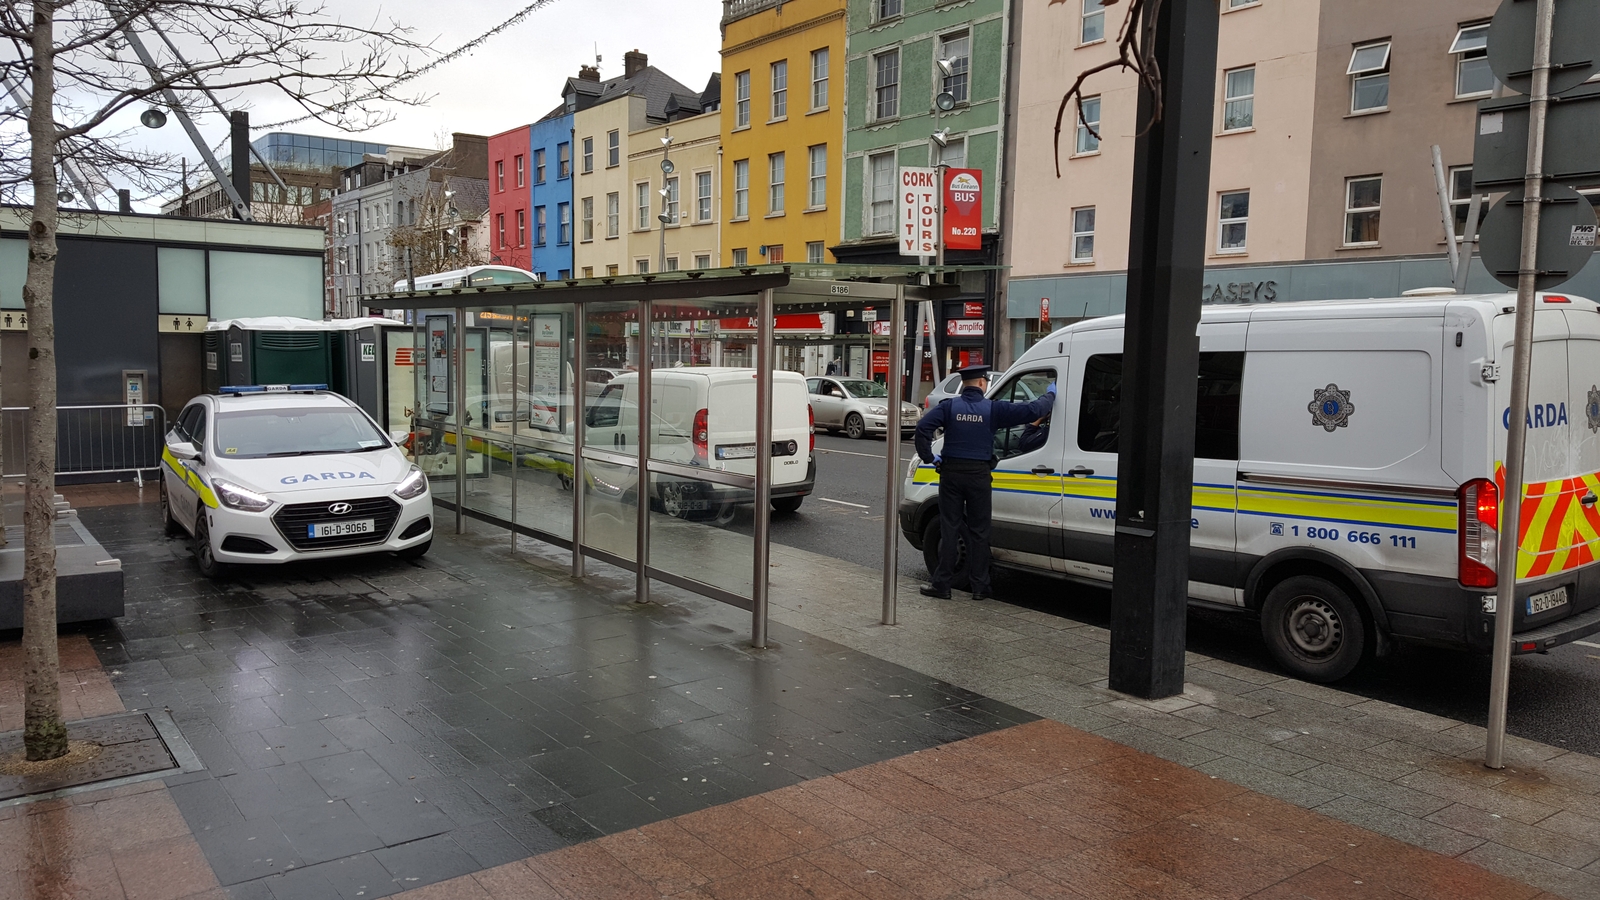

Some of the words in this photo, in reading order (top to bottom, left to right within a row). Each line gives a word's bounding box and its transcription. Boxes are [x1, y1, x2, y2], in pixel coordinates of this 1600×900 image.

[903, 171, 933, 187] CORK
[954, 192, 975, 202] BUS
[905, 193, 914, 250] CITY
[922, 194, 932, 251] TOURS
[952, 227, 976, 236] No.220
[1202, 281, 1277, 302] CASEYS
[956, 414, 983, 422] GARDA
[280, 472, 375, 484] GARDA
[322, 522, 367, 536] 161-D-9066
[1291, 526, 1298, 536] 1
[1307, 527, 1339, 540] 800
[1348, 531, 1380, 544] 666
[1390, 535, 1416, 548] 111
